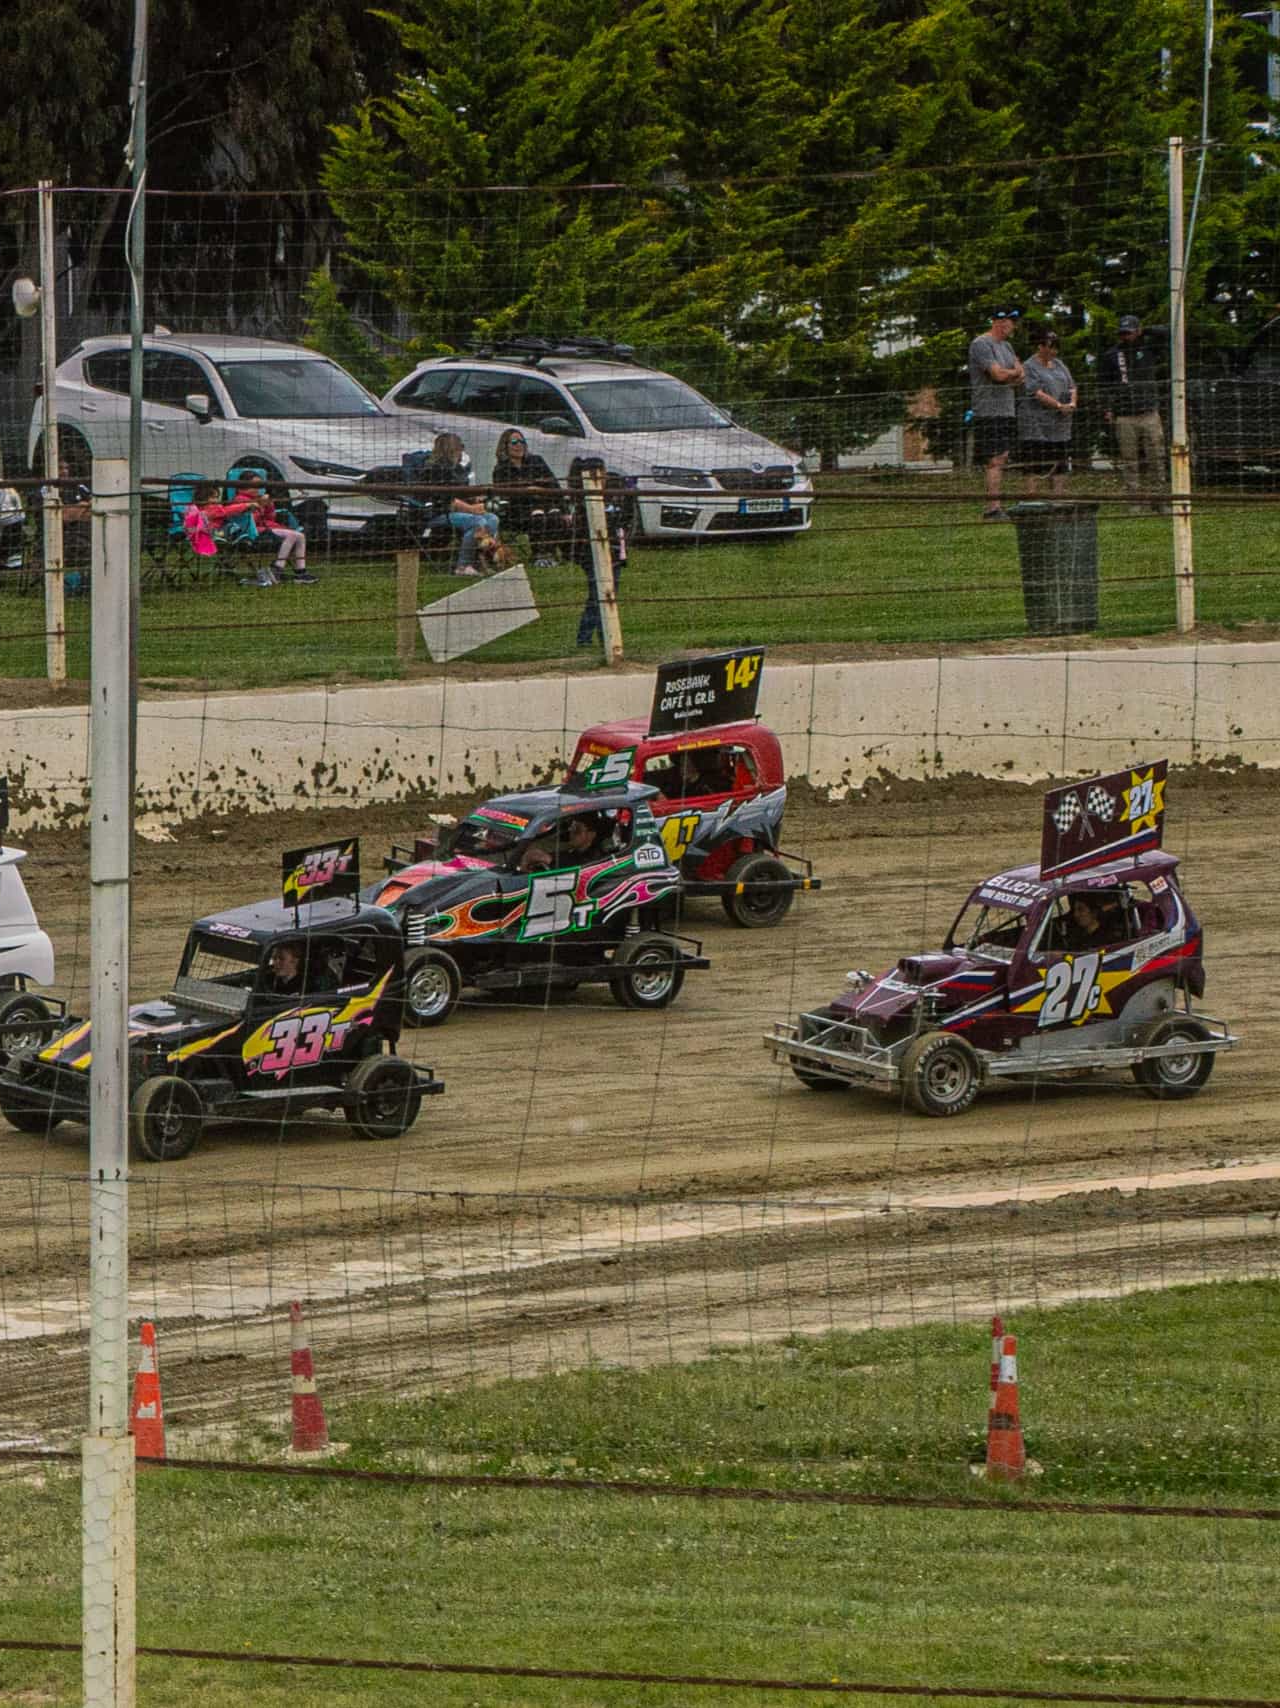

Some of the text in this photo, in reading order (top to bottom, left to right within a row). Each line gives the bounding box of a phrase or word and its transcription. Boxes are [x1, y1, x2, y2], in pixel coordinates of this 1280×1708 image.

[664, 674, 711, 694] ROSEBANK
[725, 656, 760, 692] 14T
[298, 848, 353, 887] 33T
[522, 872, 595, 938] 5T
[260, 1012, 353, 1073] 33T
